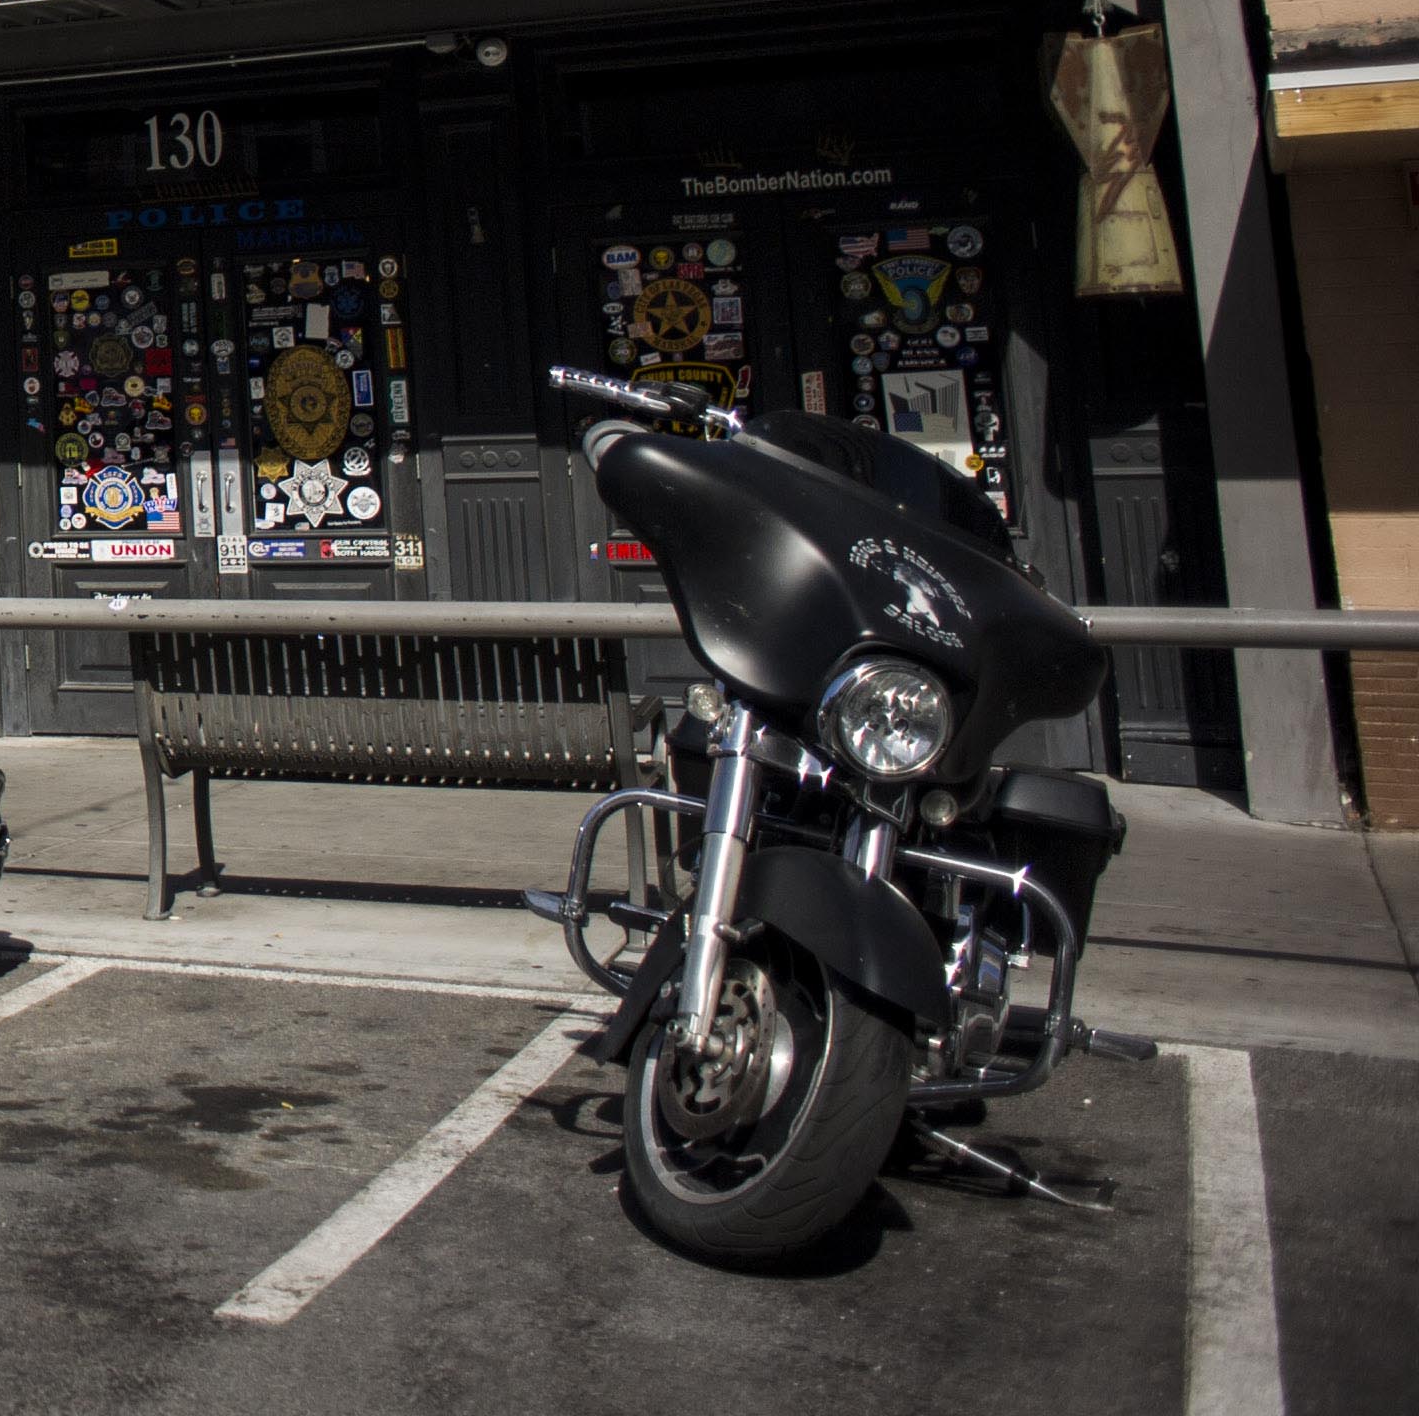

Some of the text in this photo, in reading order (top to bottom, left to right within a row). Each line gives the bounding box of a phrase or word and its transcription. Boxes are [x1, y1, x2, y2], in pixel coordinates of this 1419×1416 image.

[143, 110, 224, 172] 130
[680, 166, 893, 198] TheBomberNation.com
[106, 198, 308, 233] POLICE
[888, 265, 935, 278] POLICE
[110, 544, 173, 557] UNION
